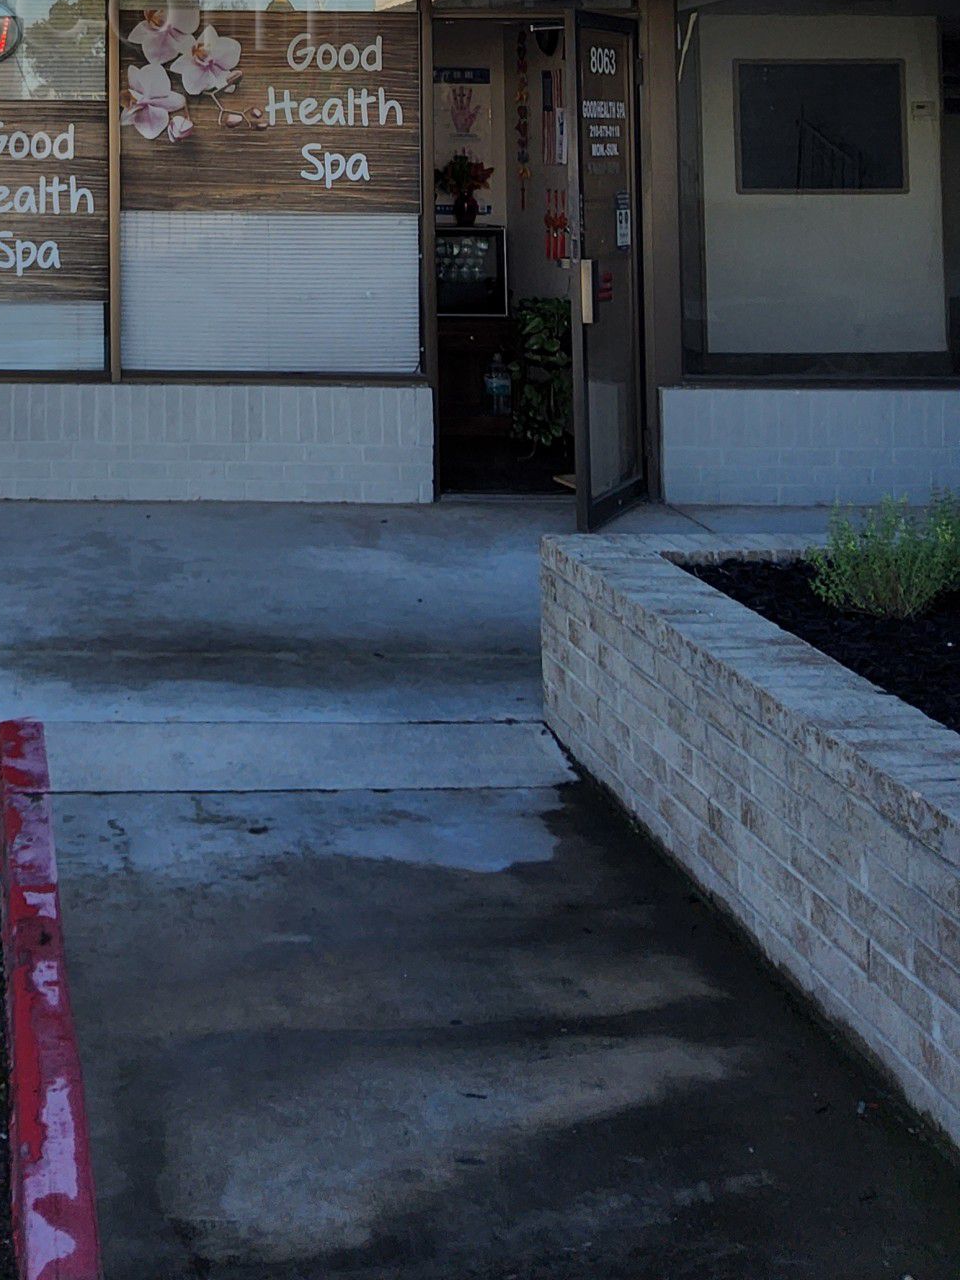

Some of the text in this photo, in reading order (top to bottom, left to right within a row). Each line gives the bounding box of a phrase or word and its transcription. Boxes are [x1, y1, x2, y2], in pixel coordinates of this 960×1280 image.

[286, 32, 384, 73] Good
[590, 46, 616, 76] 8063
[266, 87, 404, 127] Health
[299, 143, 372, 189] Spa
